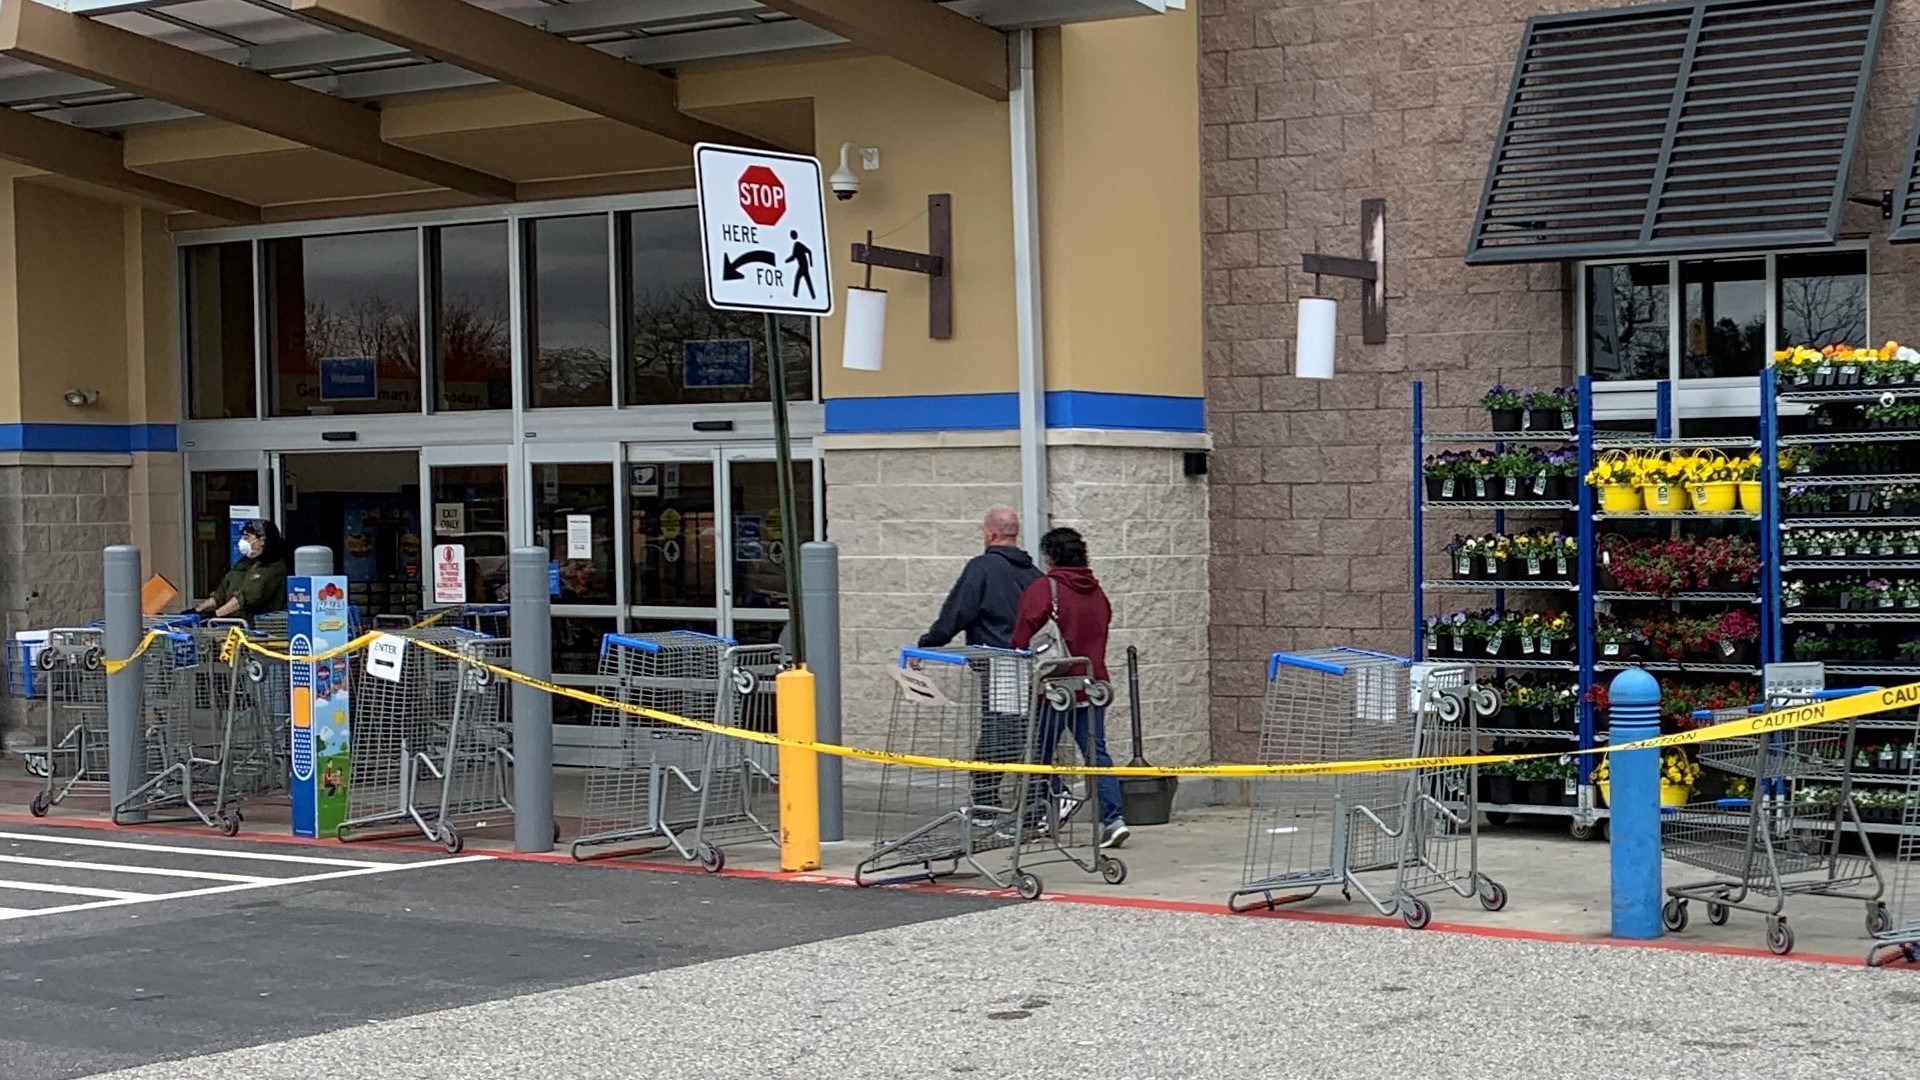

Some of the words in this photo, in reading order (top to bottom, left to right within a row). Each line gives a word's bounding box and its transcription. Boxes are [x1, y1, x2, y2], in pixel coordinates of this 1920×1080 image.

[740, 182, 784, 208] STOP
[722, 224, 759, 244] HERE
[757, 268, 784, 287] FOR
[374, 641, 397, 655] ENTER
[1882, 685, 1920, 706] CAU
[1751, 705, 1825, 730] CAUTION
